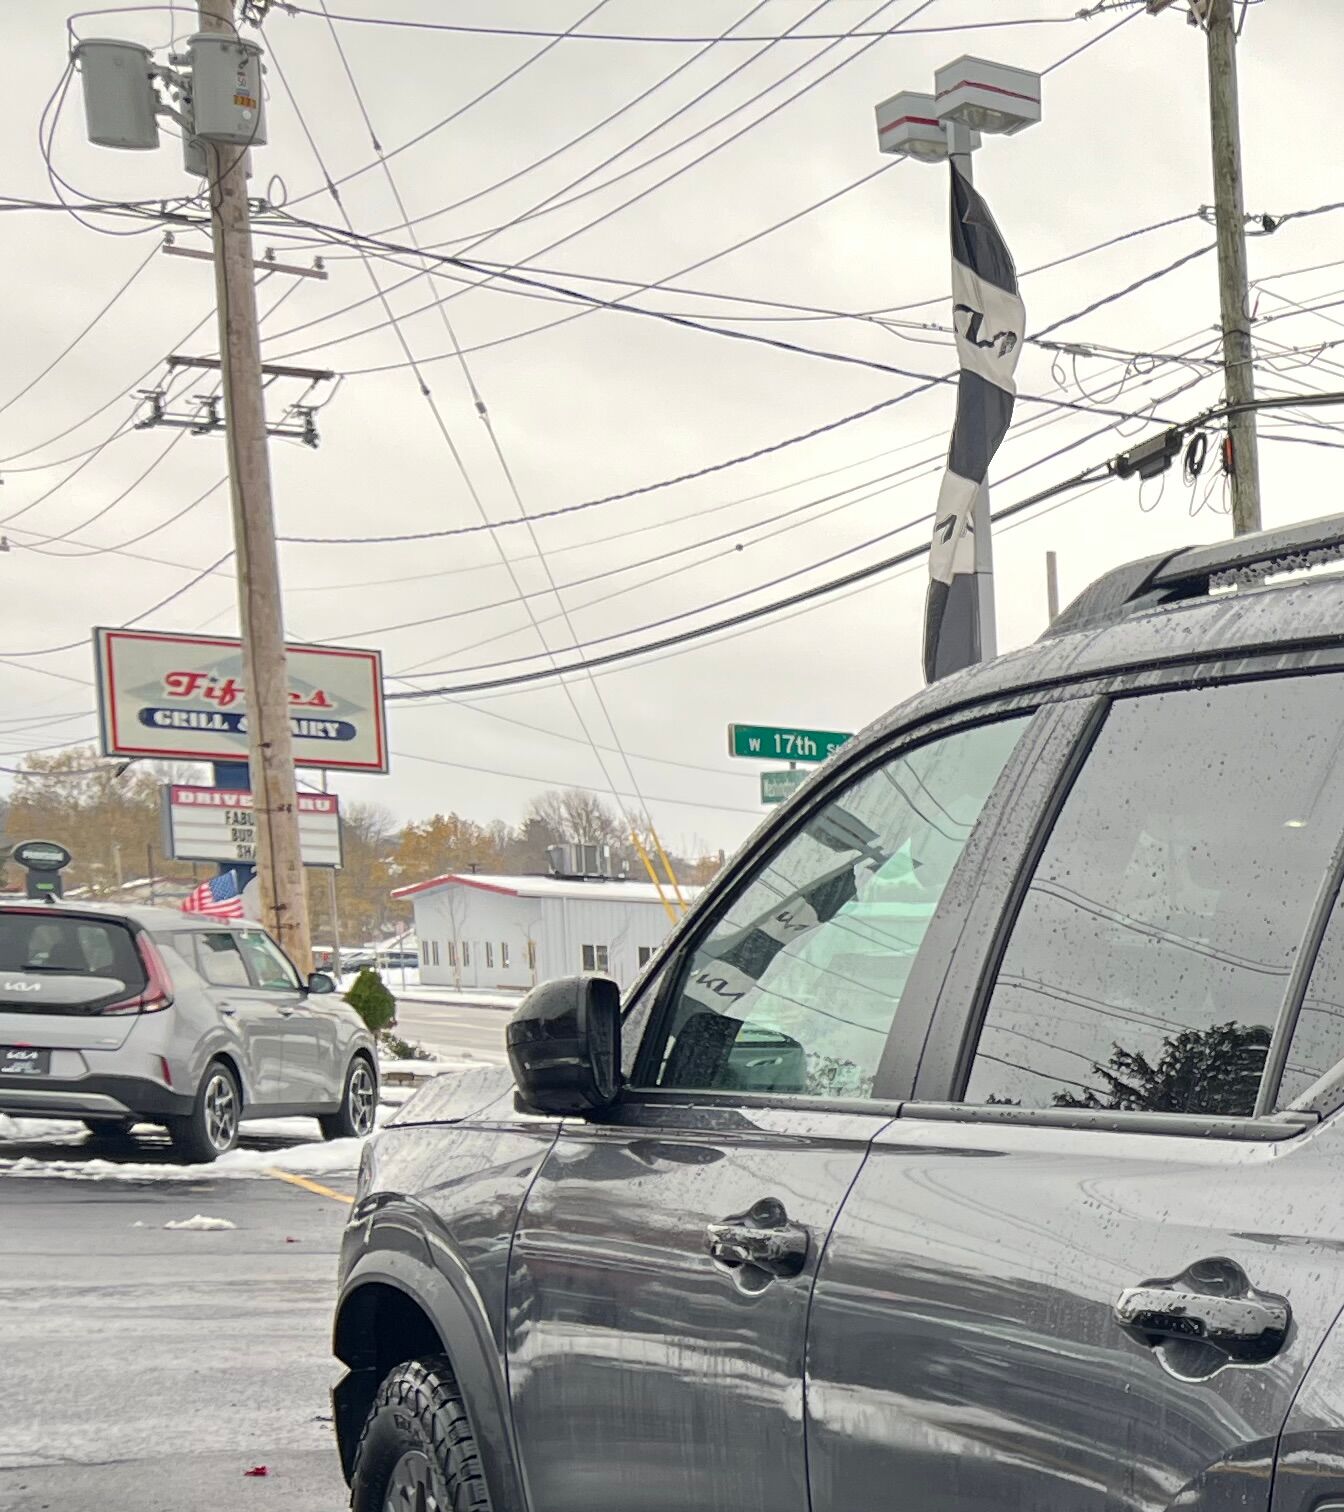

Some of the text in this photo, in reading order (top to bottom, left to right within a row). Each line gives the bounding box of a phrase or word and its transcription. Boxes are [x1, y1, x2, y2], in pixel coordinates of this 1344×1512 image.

[153, 709, 230, 732] GRILL
[289, 718, 340, 738] AIRY
[773, 733, 817, 756] 17th
[177, 791, 254, 807] DRIVE
